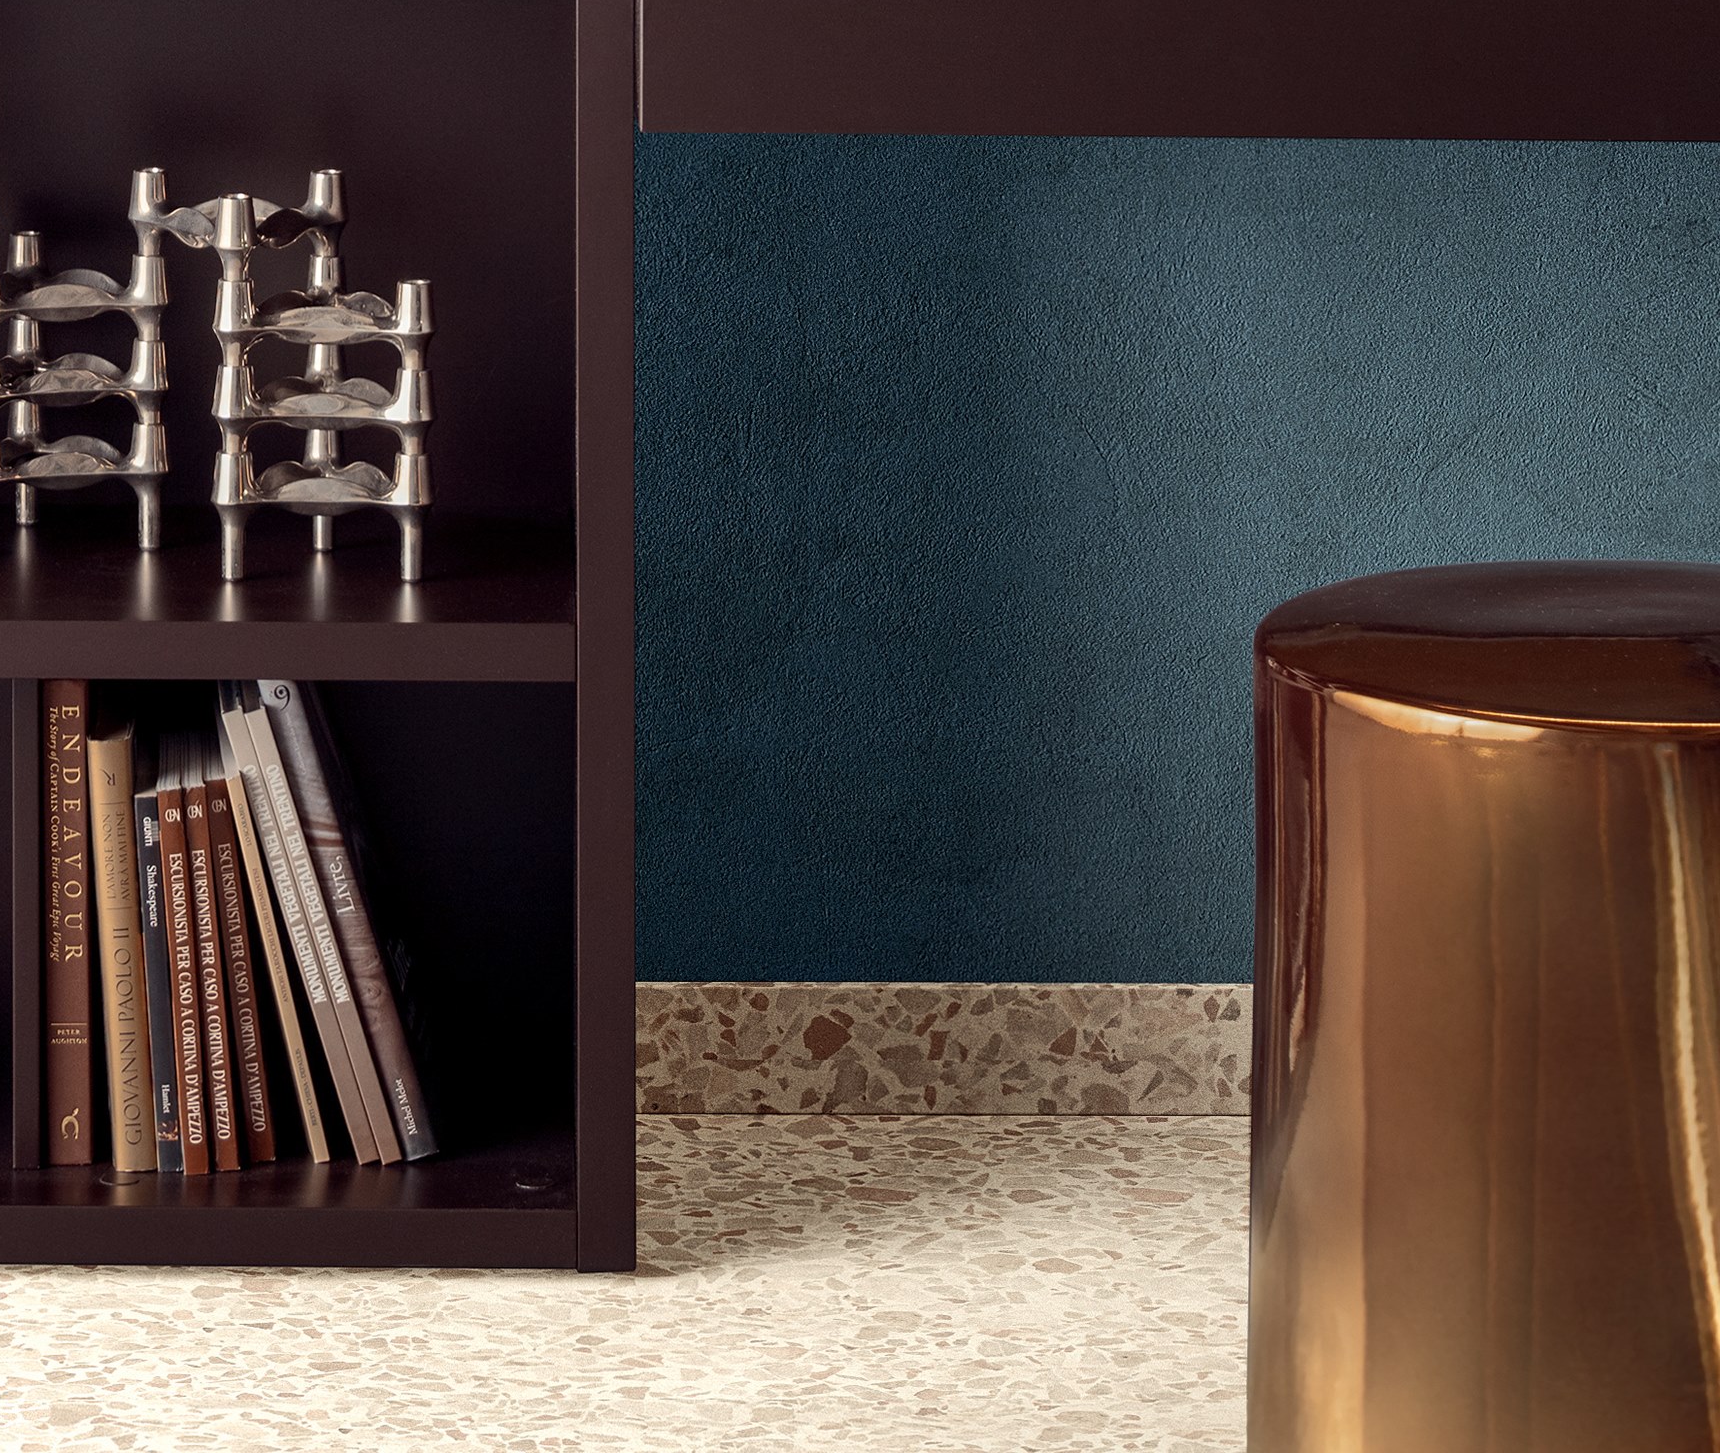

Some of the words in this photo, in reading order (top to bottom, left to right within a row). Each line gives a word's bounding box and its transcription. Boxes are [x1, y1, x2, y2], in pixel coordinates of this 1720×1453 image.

[49, 763, 60, 812] CAPTAIN
[242, 763, 275, 832] TRENTINO
[265, 763, 297, 831] TRENTINO
[61, 705, 83, 962] ENDEAVOUR
[142, 816, 153, 847] GIUNTI
[286, 830, 305, 858] NEL
[146, 865, 158, 928] Shakespeare
[168, 852, 189, 943] ESCURSIONISTA
[191, 849, 211, 939] ESCURSIONISTA
[217, 842, 241, 934] ESCURSIONISTA
[272, 857, 302, 924] VEGETALI
[294, 857, 323, 924] VEGETALI
[329, 854, 356, 916] Livre,
[112, 927, 129, 939] II
[176, 945, 191, 970] PER
[200, 941, 216, 966] PER
[229, 934, 245, 959] PER
[291, 923, 328, 1005] MONUMENTI
[314, 922, 351, 1005] MONUMENTI
[114, 948, 135, 1022] PAOLO
[177, 972, 194, 1005] CASO
[202, 967, 219, 1001] CASO
[231, 960, 249, 993] CASO
[181, 1019, 198, 1072] CORTINA
[206, 1014, 225, 1068] CORTINA
[237, 1007, 257, 1061] CORTINA
[119, 1031, 143, 1146] GIOVANNI
[161, 1084, 171, 1114] Hamlet
[184, 1073, 203, 1145] D'AMPEZZO
[211, 1069, 231, 1140] D'AMPEZZO
[244, 1062, 266, 1133] D'AMPEZZO
[400, 1104, 418, 1136] Michel
